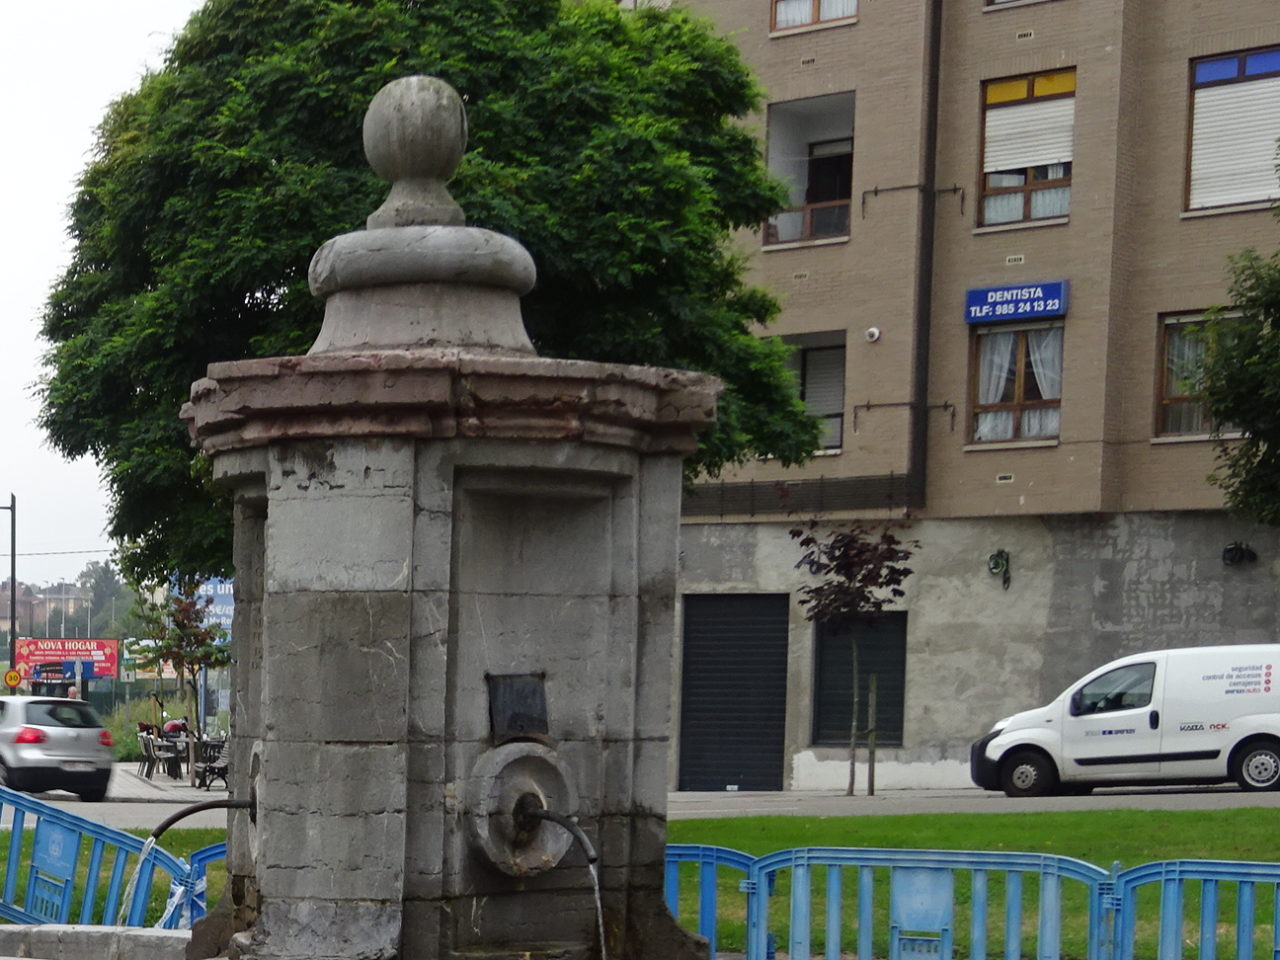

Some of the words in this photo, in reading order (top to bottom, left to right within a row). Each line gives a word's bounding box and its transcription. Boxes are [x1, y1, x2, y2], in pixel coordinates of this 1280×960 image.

[987, 287, 1043, 303] DENTISTA
[970, 305, 993, 317] TLF:
[995, 303, 1015, 315] 985
[1017, 303, 1031, 313] 24
[1033, 300, 1044, 312] 13
[1046, 299, 1060, 310] 23
[38, 641, 62, 650] NOVA
[64, 641, 98, 650] HOGAR
